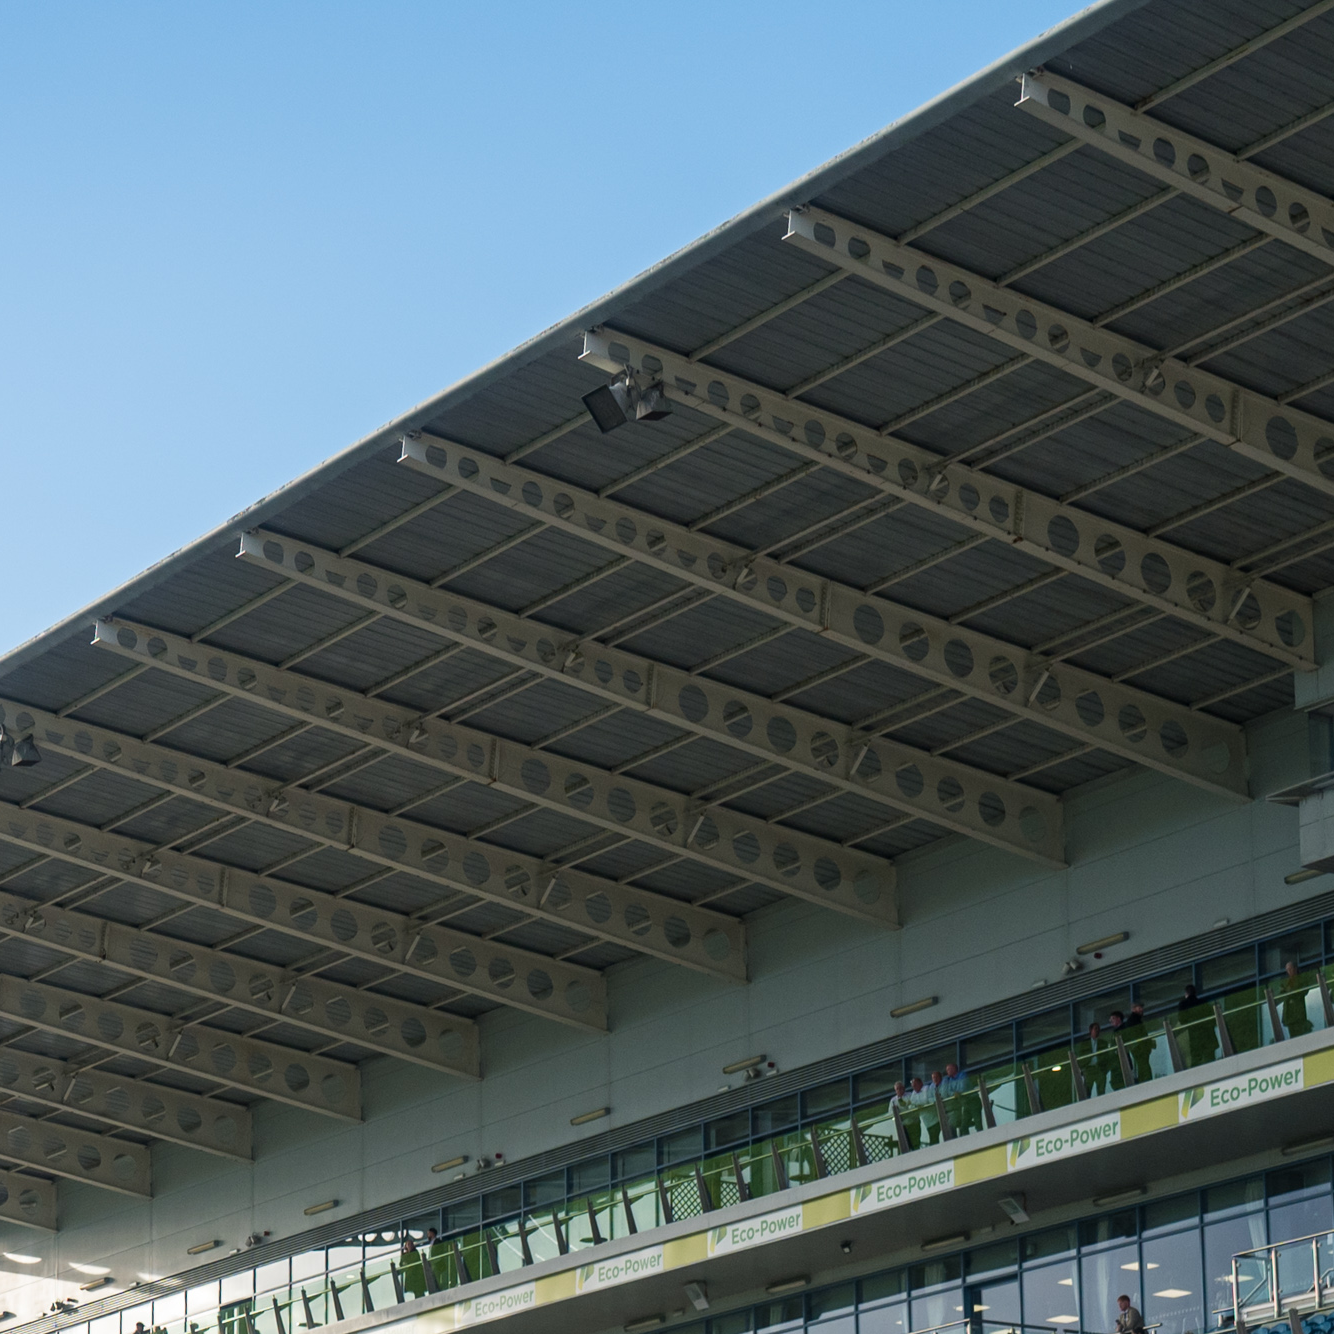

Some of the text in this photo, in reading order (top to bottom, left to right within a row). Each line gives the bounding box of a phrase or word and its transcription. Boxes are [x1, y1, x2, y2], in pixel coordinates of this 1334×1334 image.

[1210, 1065, 1302, 1107] Eco-Power
[1035, 1118, 1119, 1158] Eco-Power
[876, 1167, 953, 1203] Eco-Power
[731, 1211, 801, 1245] Eco-Power
[597, 1252, 662, 1283] Eco-Power
[474, 1288, 535, 1318] Eco-Power
